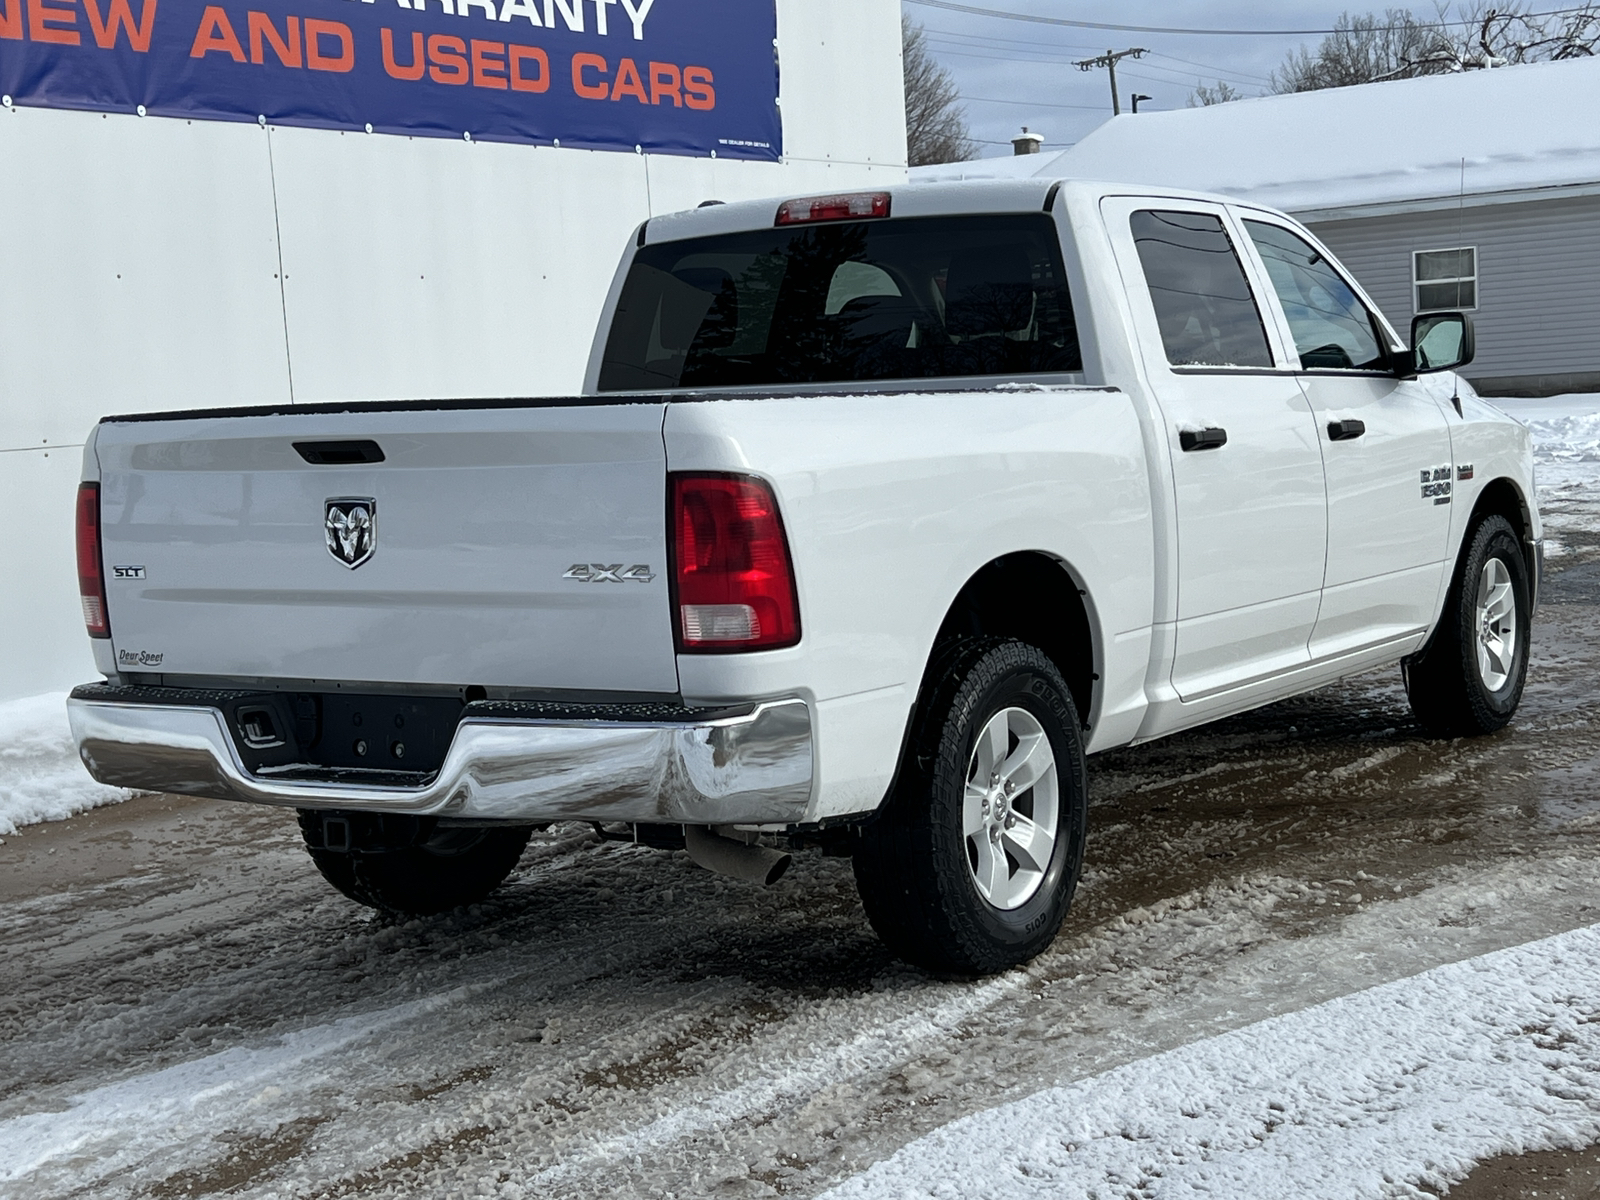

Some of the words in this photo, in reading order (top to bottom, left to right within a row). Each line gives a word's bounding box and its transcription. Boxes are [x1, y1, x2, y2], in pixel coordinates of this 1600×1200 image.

[340, 0, 653, 41] ANTY
[190, 5, 355, 73] AND
[380, 27, 550, 94] USED
[571, 52, 716, 111] CARS
[114, 566, 144, 578] SLT
